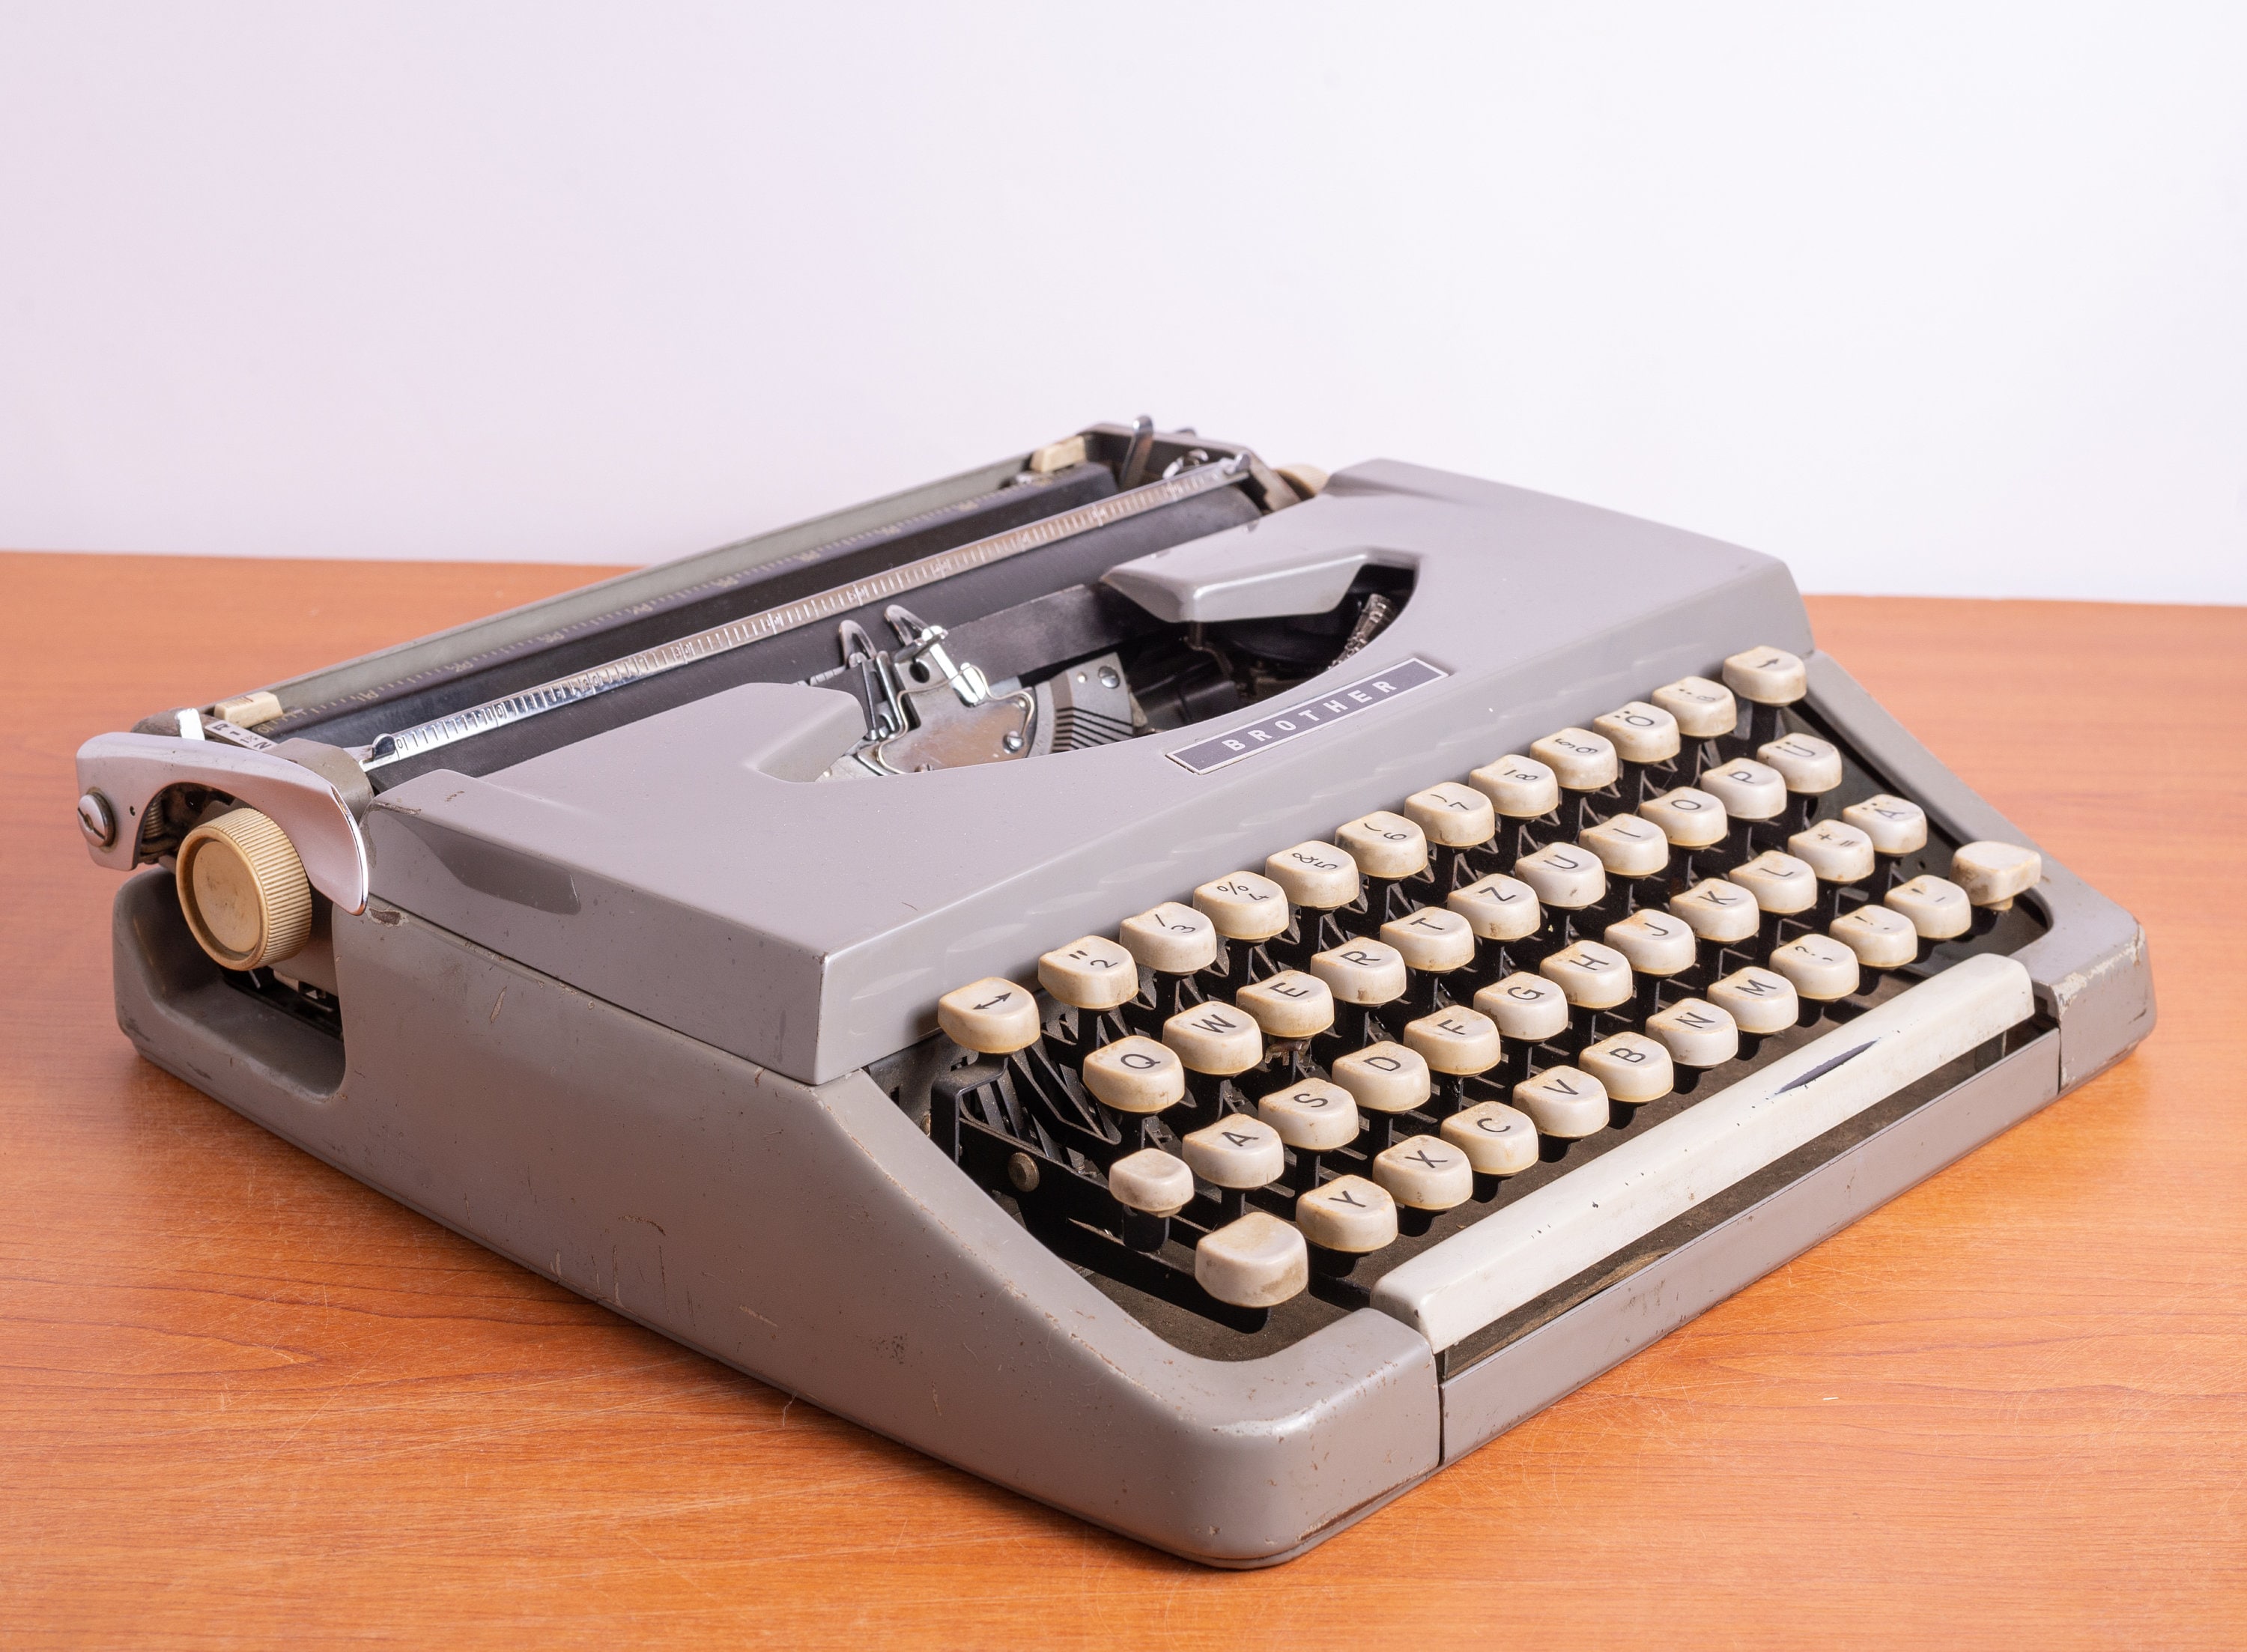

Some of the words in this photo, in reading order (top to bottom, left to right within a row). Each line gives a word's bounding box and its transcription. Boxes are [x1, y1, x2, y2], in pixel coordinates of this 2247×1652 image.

[1222, 681, 1397, 750] BROTHER
[1575, 746, 1598, 754] 9
[1775, 741, 1816, 758] Ü
[1728, 771, 1754, 784] P
[1449, 801, 1470, 810] 7
[1670, 799, 1702, 811] O
[1861, 803, 1904, 819] Ä
[1383, 832, 1407, 840] 6
[1291, 852, 1319, 863] &
[1543, 854, 1579, 869] U
[1313, 860, 1338, 871] 5
[1759, 867, 1795, 878] L
[1249, 893, 1270, 901] 4
[1478, 886, 1517, 902] Z
[1697, 890, 1737, 905] K
[1171, 925, 1196, 933] 3
[1409, 917, 1445, 931] T
[1643, 922, 1669, 937] J
[1339, 950, 1381, 966] R
[1795, 946, 1816, 956] ?
[1090, 959, 1118, 968] 2
[1568, 953, 1610, 971] H
[1269, 982, 1309, 997] E
[1507, 986, 1545, 1000] G
[1735, 979, 1777, 997] M
[1190, 1013, 1237, 1033] W
[1437, 1018, 1466, 1036] F
[1675, 1012, 1715, 1029] N
[1120, 1053, 1161, 1069] Q
[1608, 1048, 1646, 1063] B
[1362, 1056, 1401, 1072] D
[1542, 1078, 1579, 1096] V
[1293, 1093, 1329, 1108] S
[1476, 1117, 1511, 1133] C
[1221, 1132, 1259, 1147] A
[1404, 1150, 1449, 1169] X
[1328, 1190, 1367, 1208] Y
